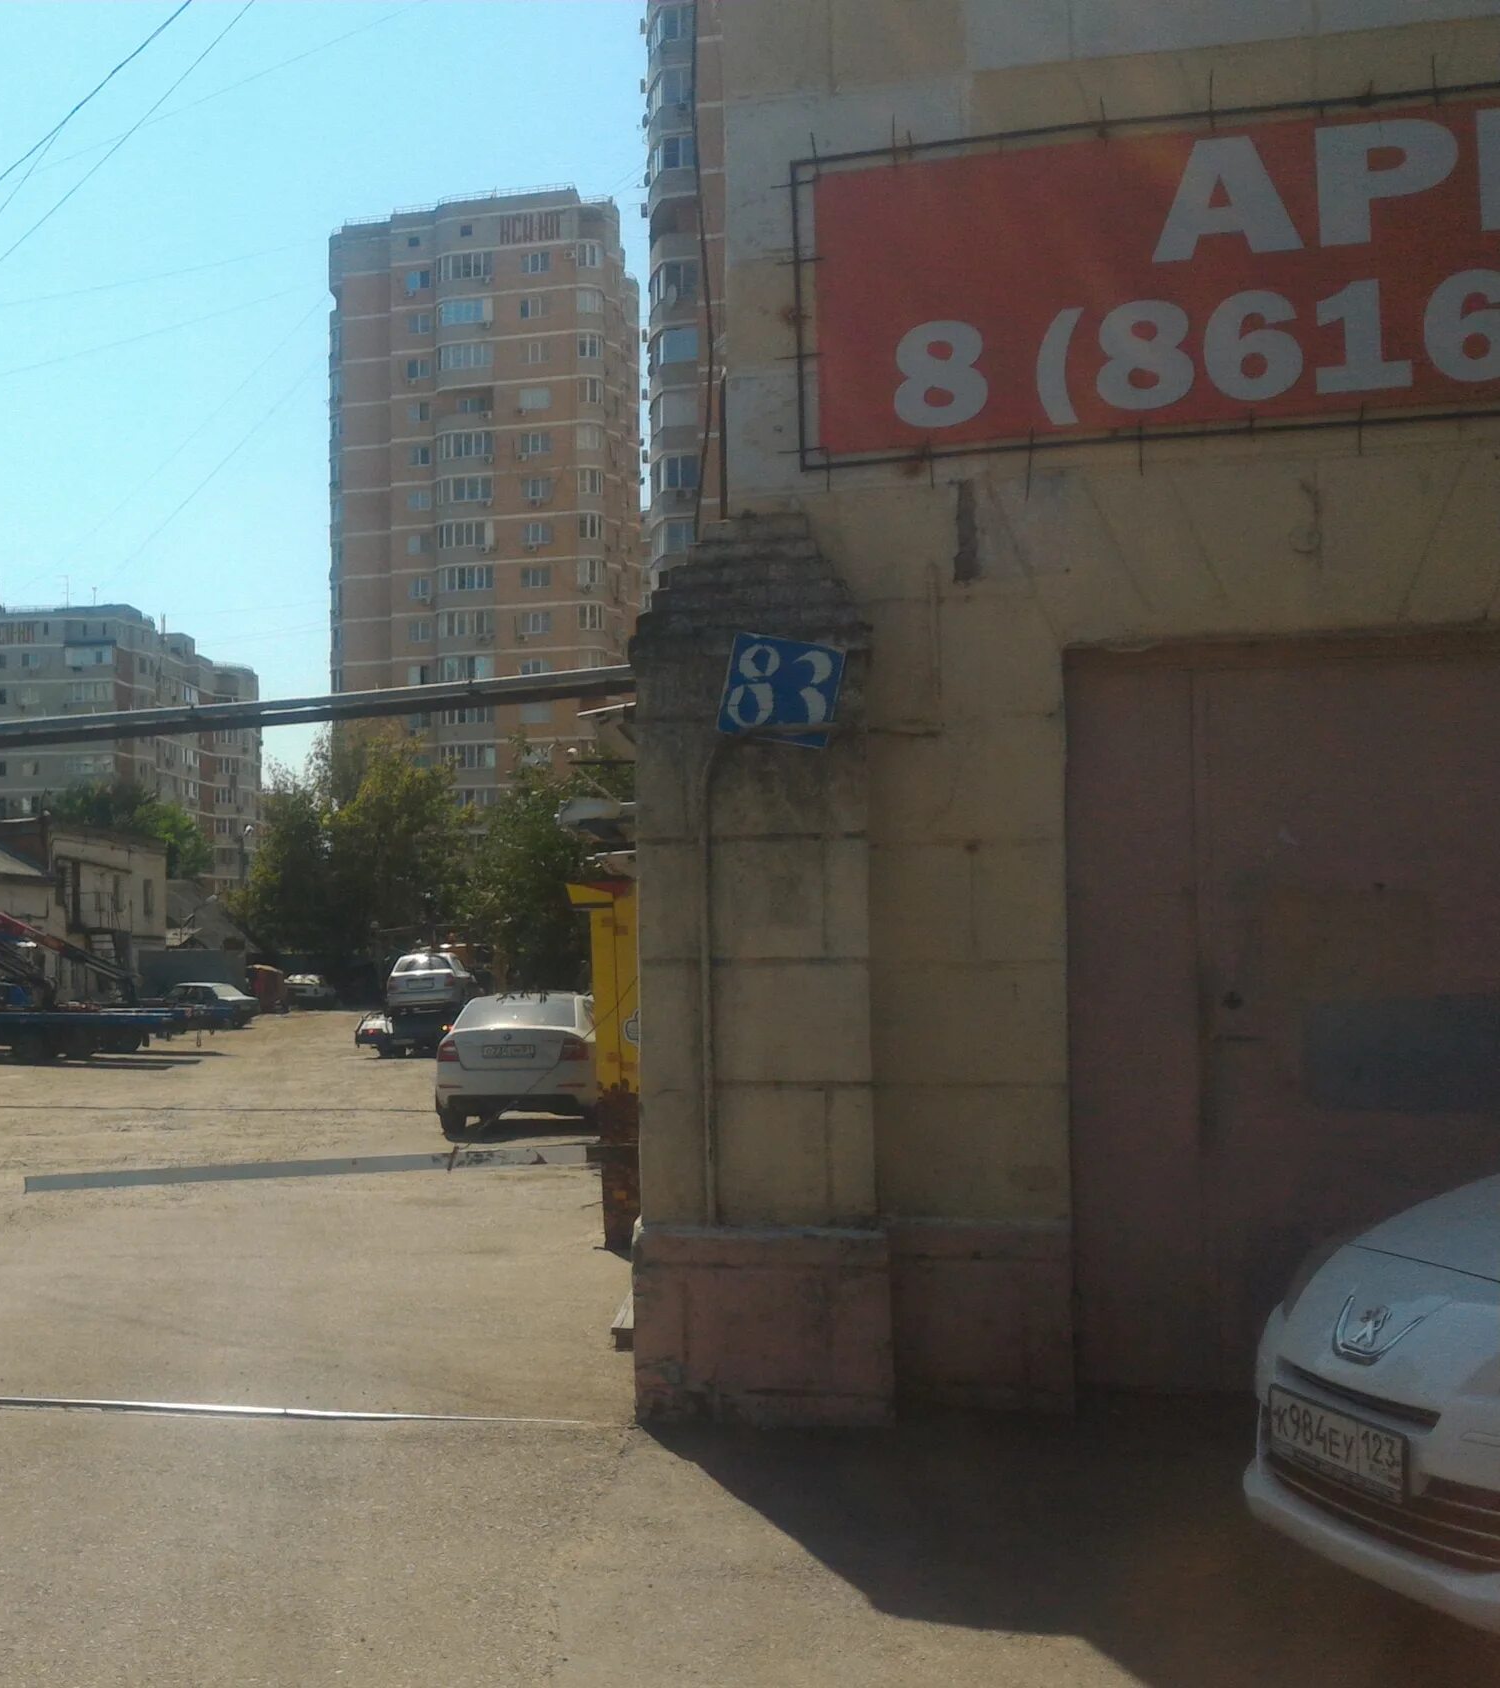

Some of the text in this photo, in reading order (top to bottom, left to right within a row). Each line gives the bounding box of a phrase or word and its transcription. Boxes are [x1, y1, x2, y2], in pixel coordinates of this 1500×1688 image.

[1152, 105, 1500, 263] АР
[893, 268, 1500, 428] 8 (8616
[727, 643, 833, 728] 83
[1361, 1430, 1397, 1468] 123
